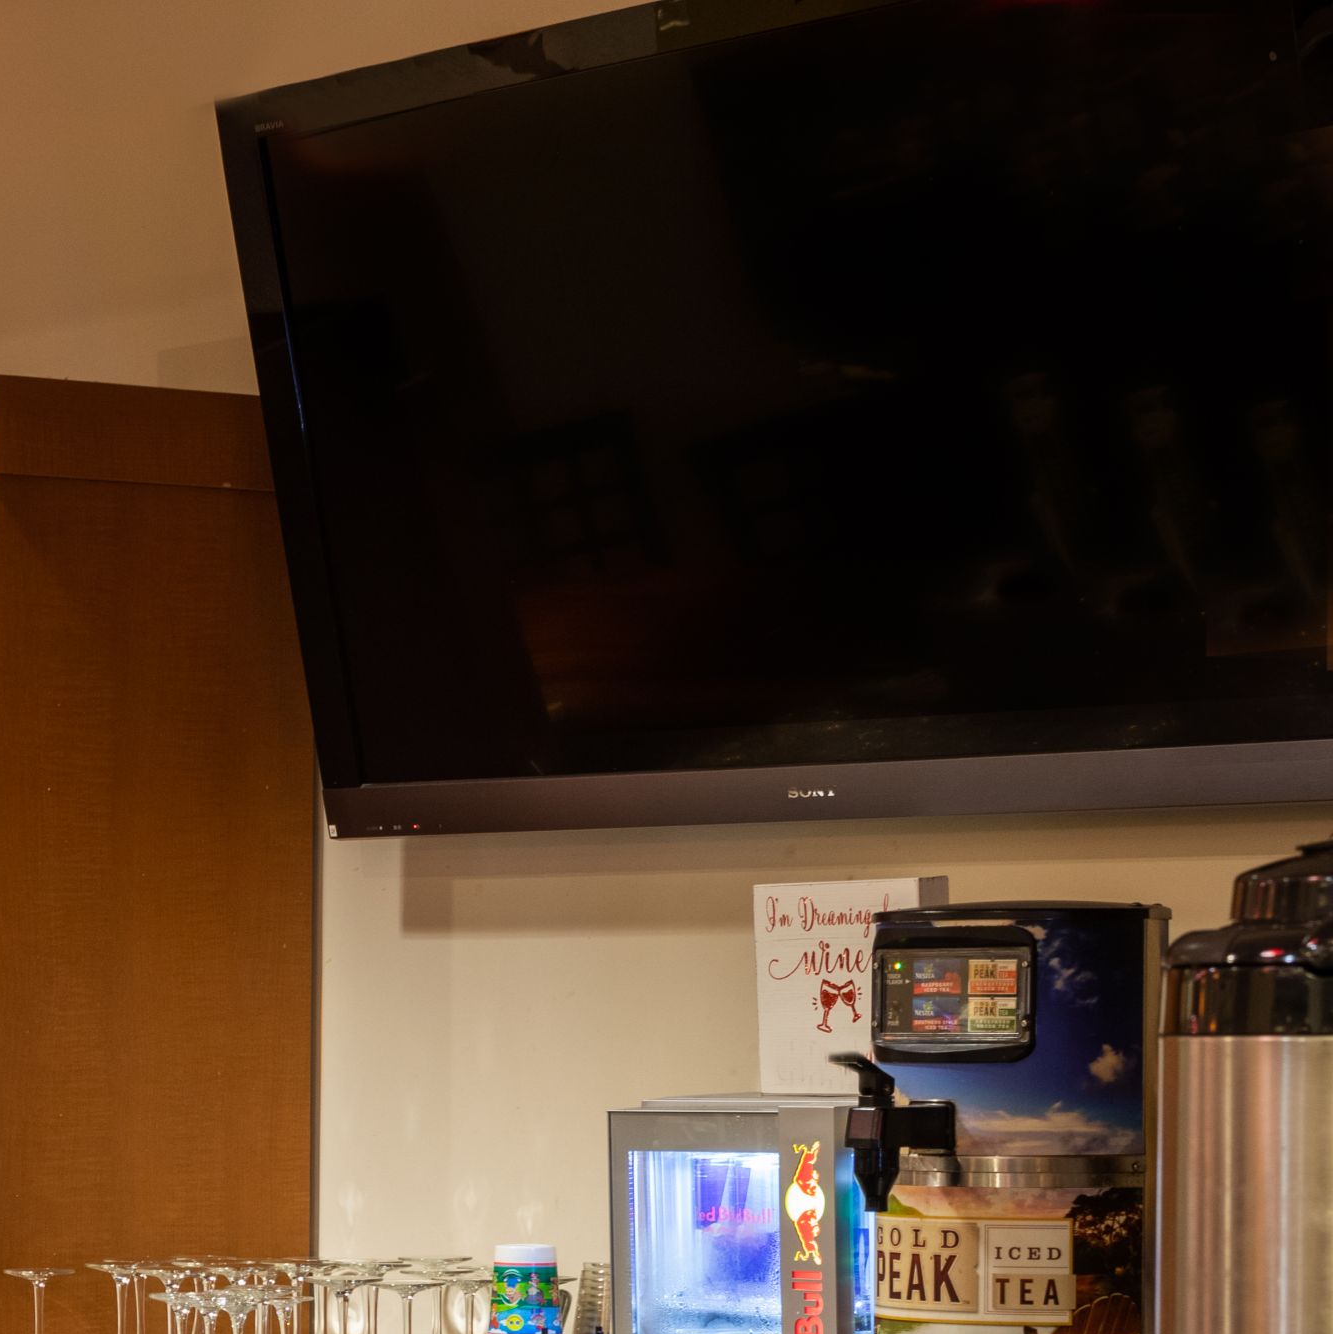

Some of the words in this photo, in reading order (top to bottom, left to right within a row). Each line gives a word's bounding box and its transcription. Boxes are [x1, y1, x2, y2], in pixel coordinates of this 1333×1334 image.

[788, 784, 837, 799] SONY
[798, 896, 875, 938] Dreaming
[973, 969, 997, 980] PEAK
[973, 1006, 997, 1018] PEAK
[876, 1226, 961, 1250] GOLD
[994, 1246, 1063, 1261] ICED
[876, 1250, 961, 1304] PEAK
[995, 1277, 1060, 1306] TEA
